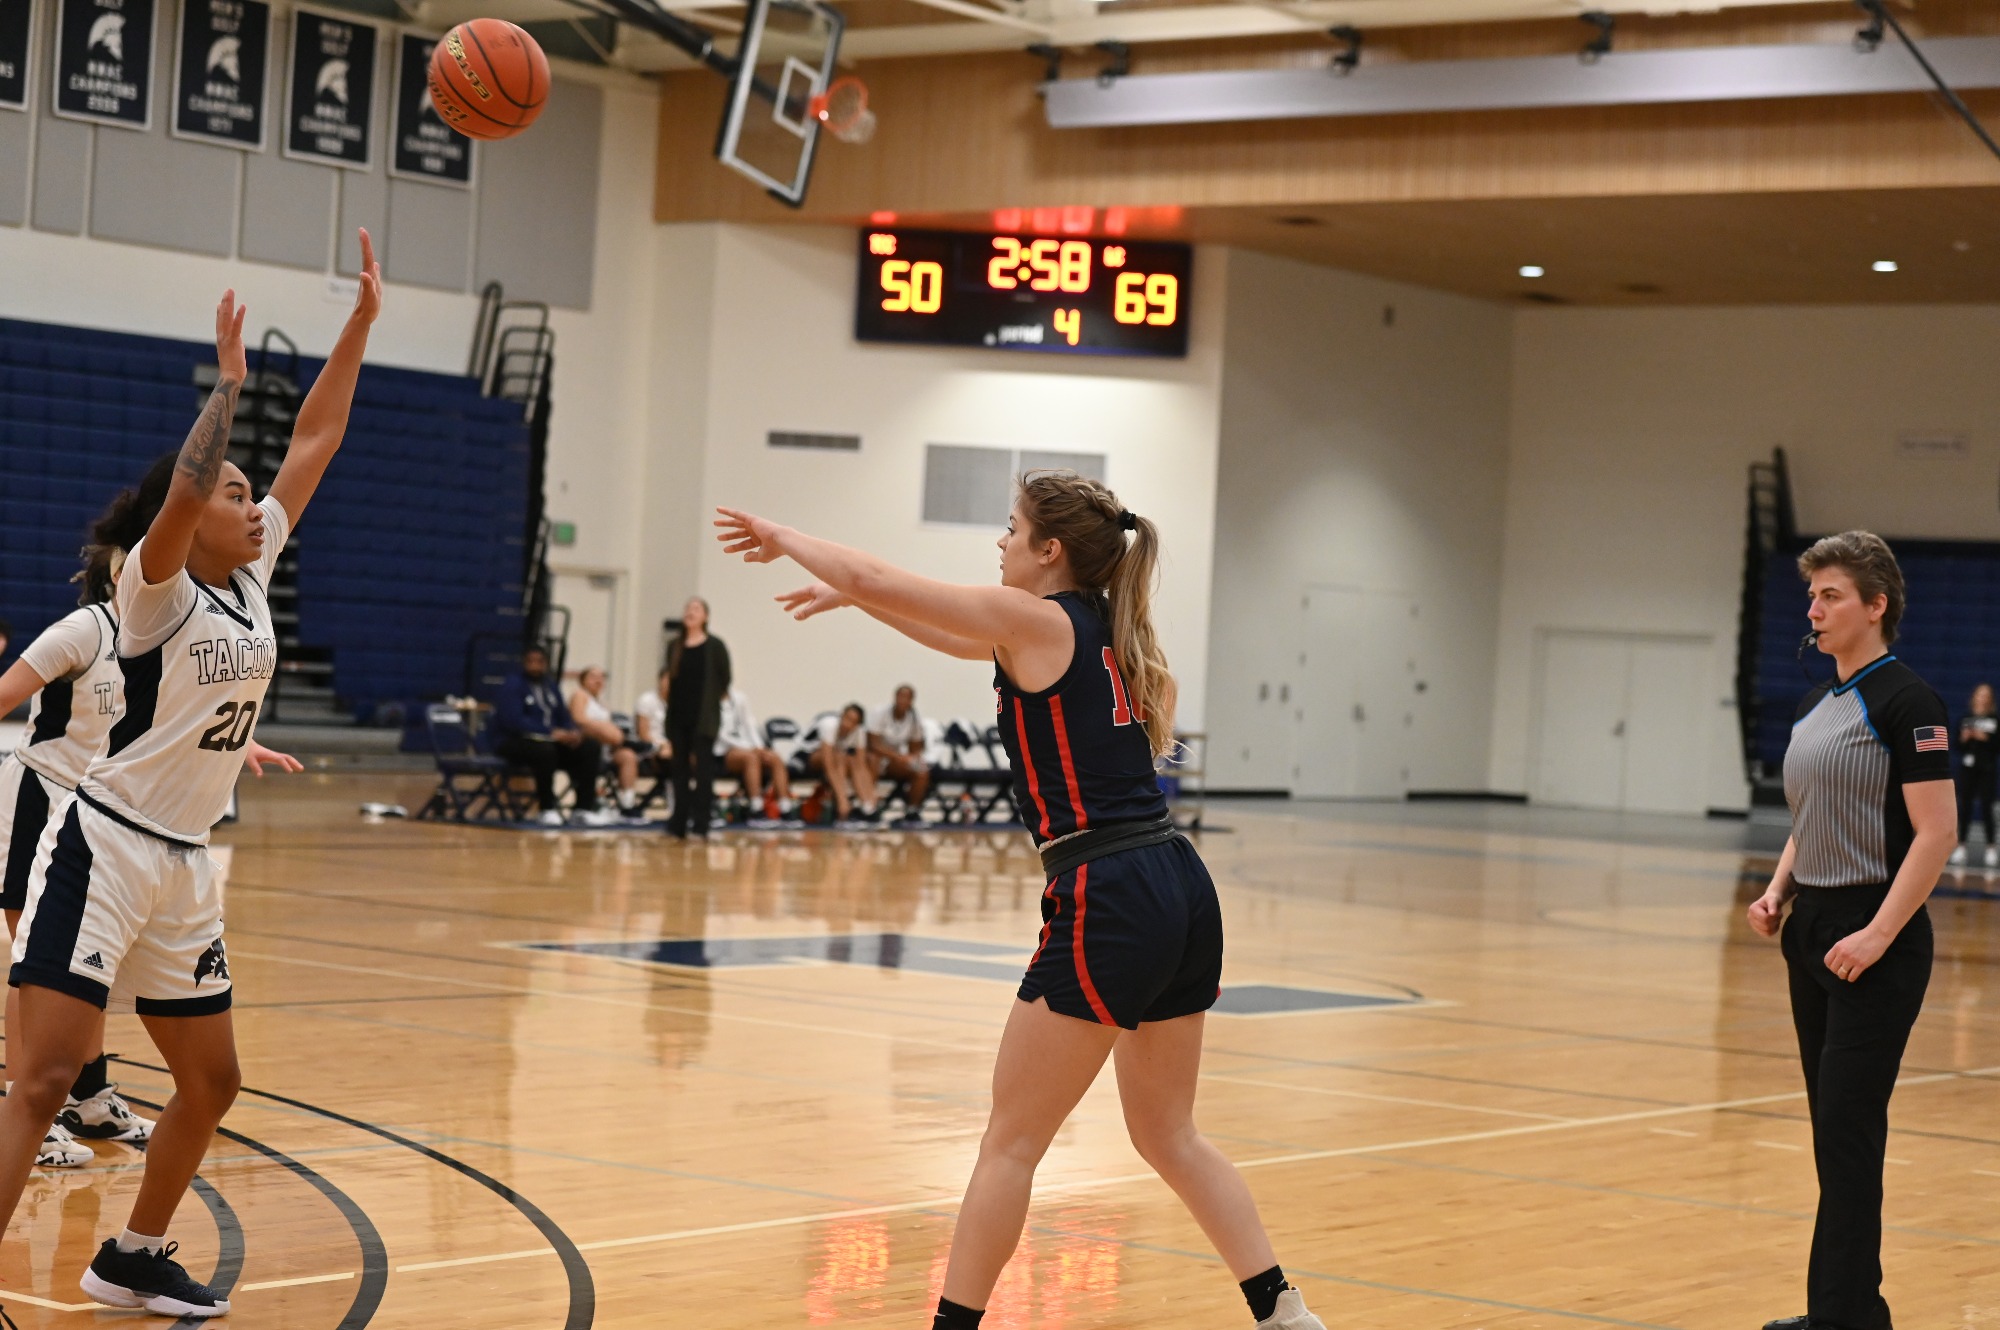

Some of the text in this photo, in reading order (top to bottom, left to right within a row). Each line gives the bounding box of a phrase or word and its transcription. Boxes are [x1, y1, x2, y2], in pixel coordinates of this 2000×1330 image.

[880, 260, 943, 313] 50
[988, 237, 1092, 293] 2:58
[1114, 272, 1178, 326] 69
[1054, 308, 1080, 346] 4
[198, 701, 257, 752] 20
